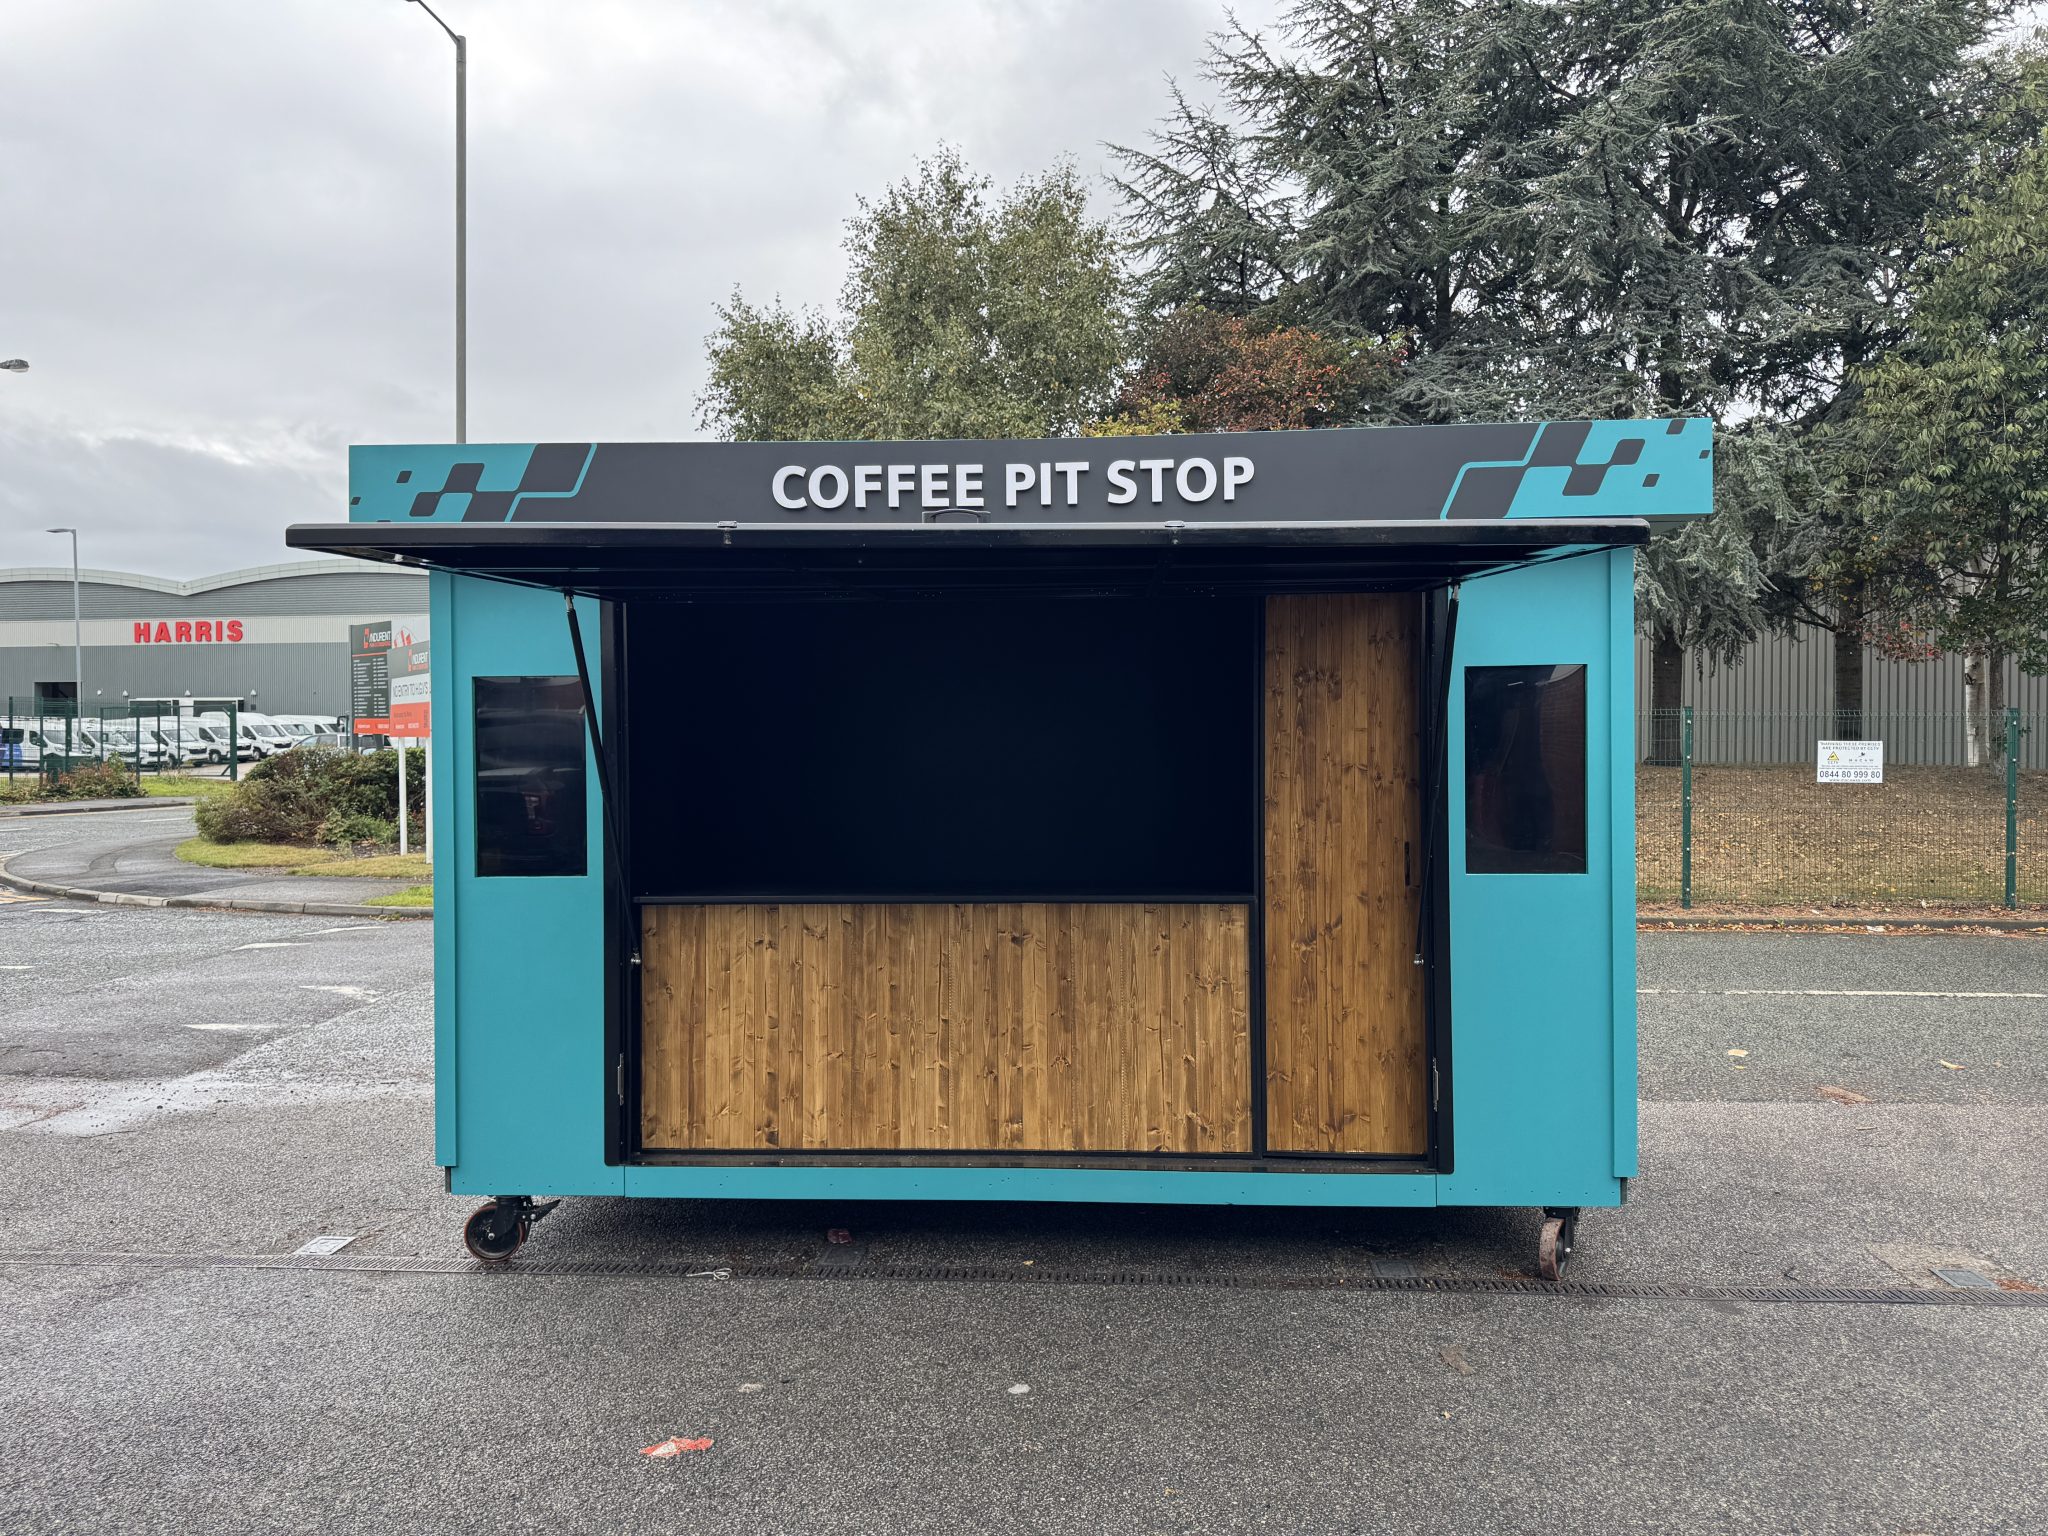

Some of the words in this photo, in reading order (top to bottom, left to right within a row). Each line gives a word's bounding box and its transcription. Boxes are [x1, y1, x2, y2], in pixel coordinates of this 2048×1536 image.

[772, 464, 985, 509] COFFEE
[1005, 461, 1090, 507] PIT
[1107, 456, 1256, 505] STOP
[134, 620, 244, 643] HARRIS
[1841, 770, 1852, 778] 80
[1853, 770, 1868, 779] 999
[1870, 771, 1881, 779] 80
